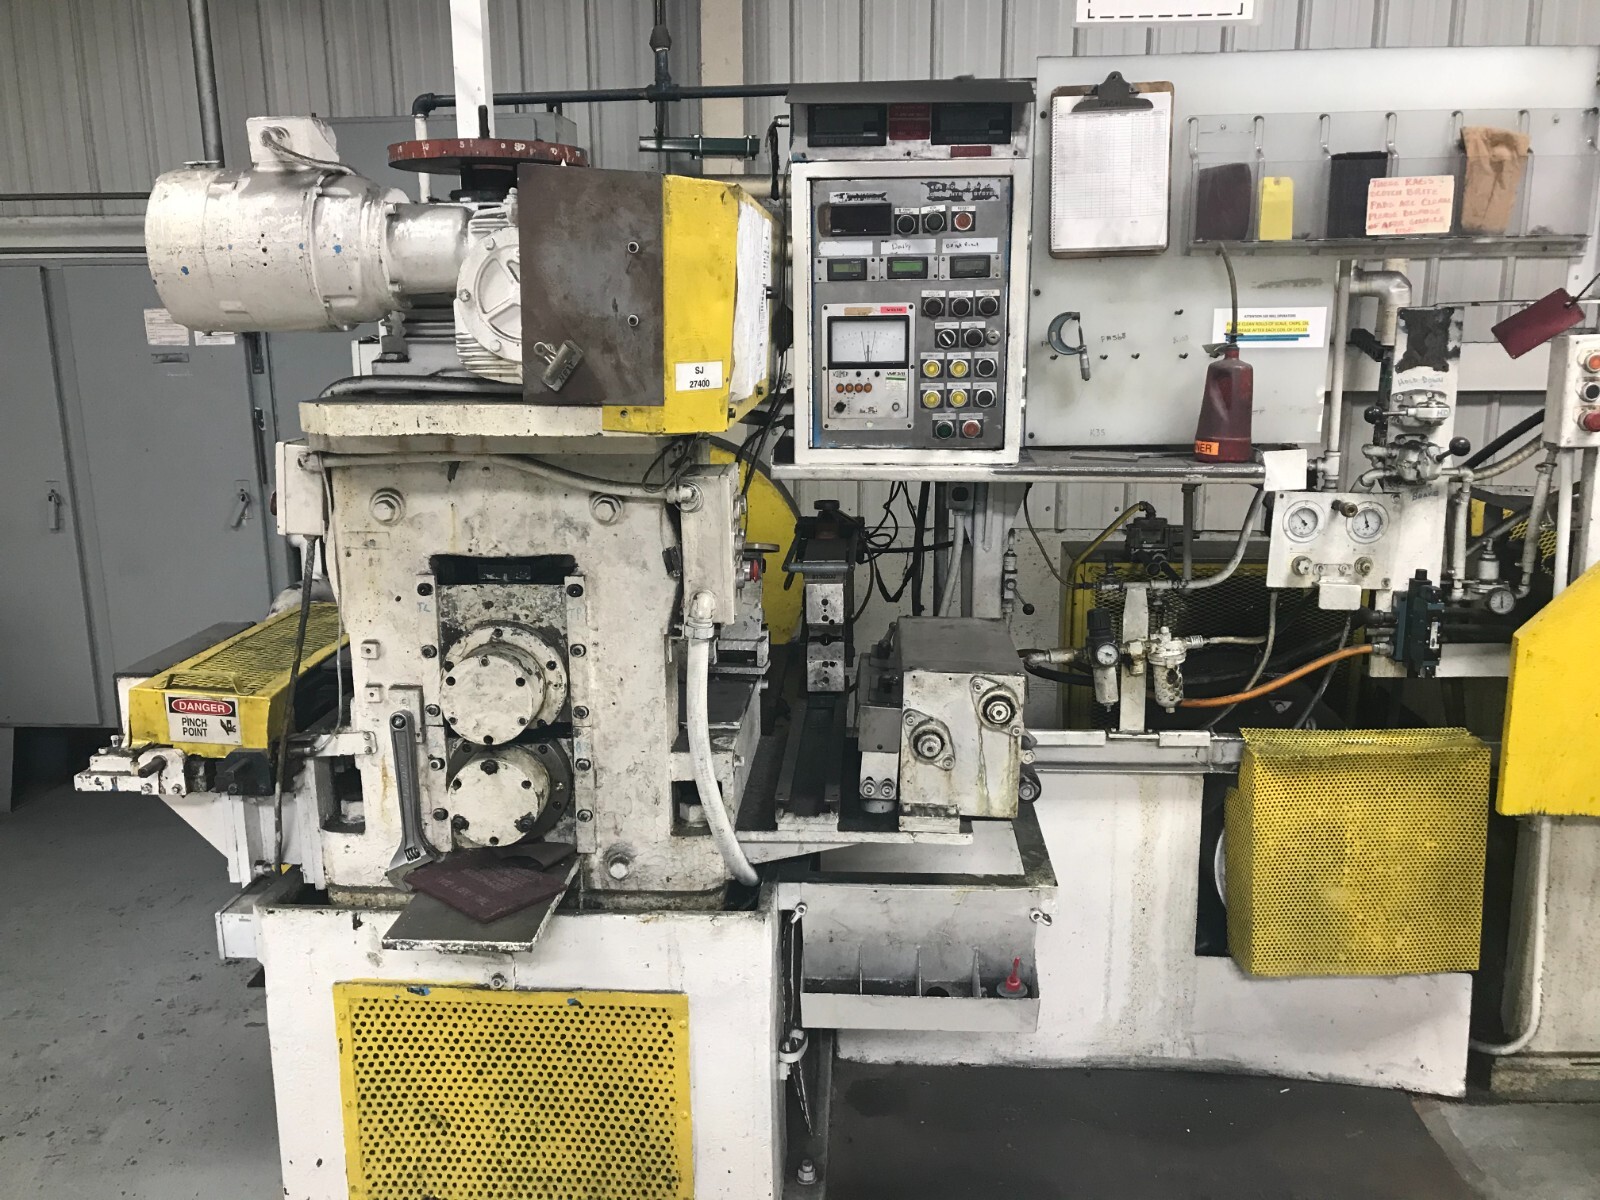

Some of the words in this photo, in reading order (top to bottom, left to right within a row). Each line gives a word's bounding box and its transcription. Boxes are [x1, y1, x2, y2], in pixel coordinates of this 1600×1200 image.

[1405, 178, 1434, 186] RAGS
[1370, 189, 1402, 198] SCOTCH
[1406, 188, 1438, 196] BRITE
[1370, 200, 1394, 210] PADS
[1399, 199, 1416, 207] ARE
[1368, 212, 1397, 221] PLEASE
[694, 366, 704, 375] SJ
[690, 379, 710, 388] 27400
[1412, 490, 1439, 502] BRAKE
[179, 701, 225, 713] DANGER
[182, 717, 208, 728] PINCH
[182, 727, 208, 737] POINT
